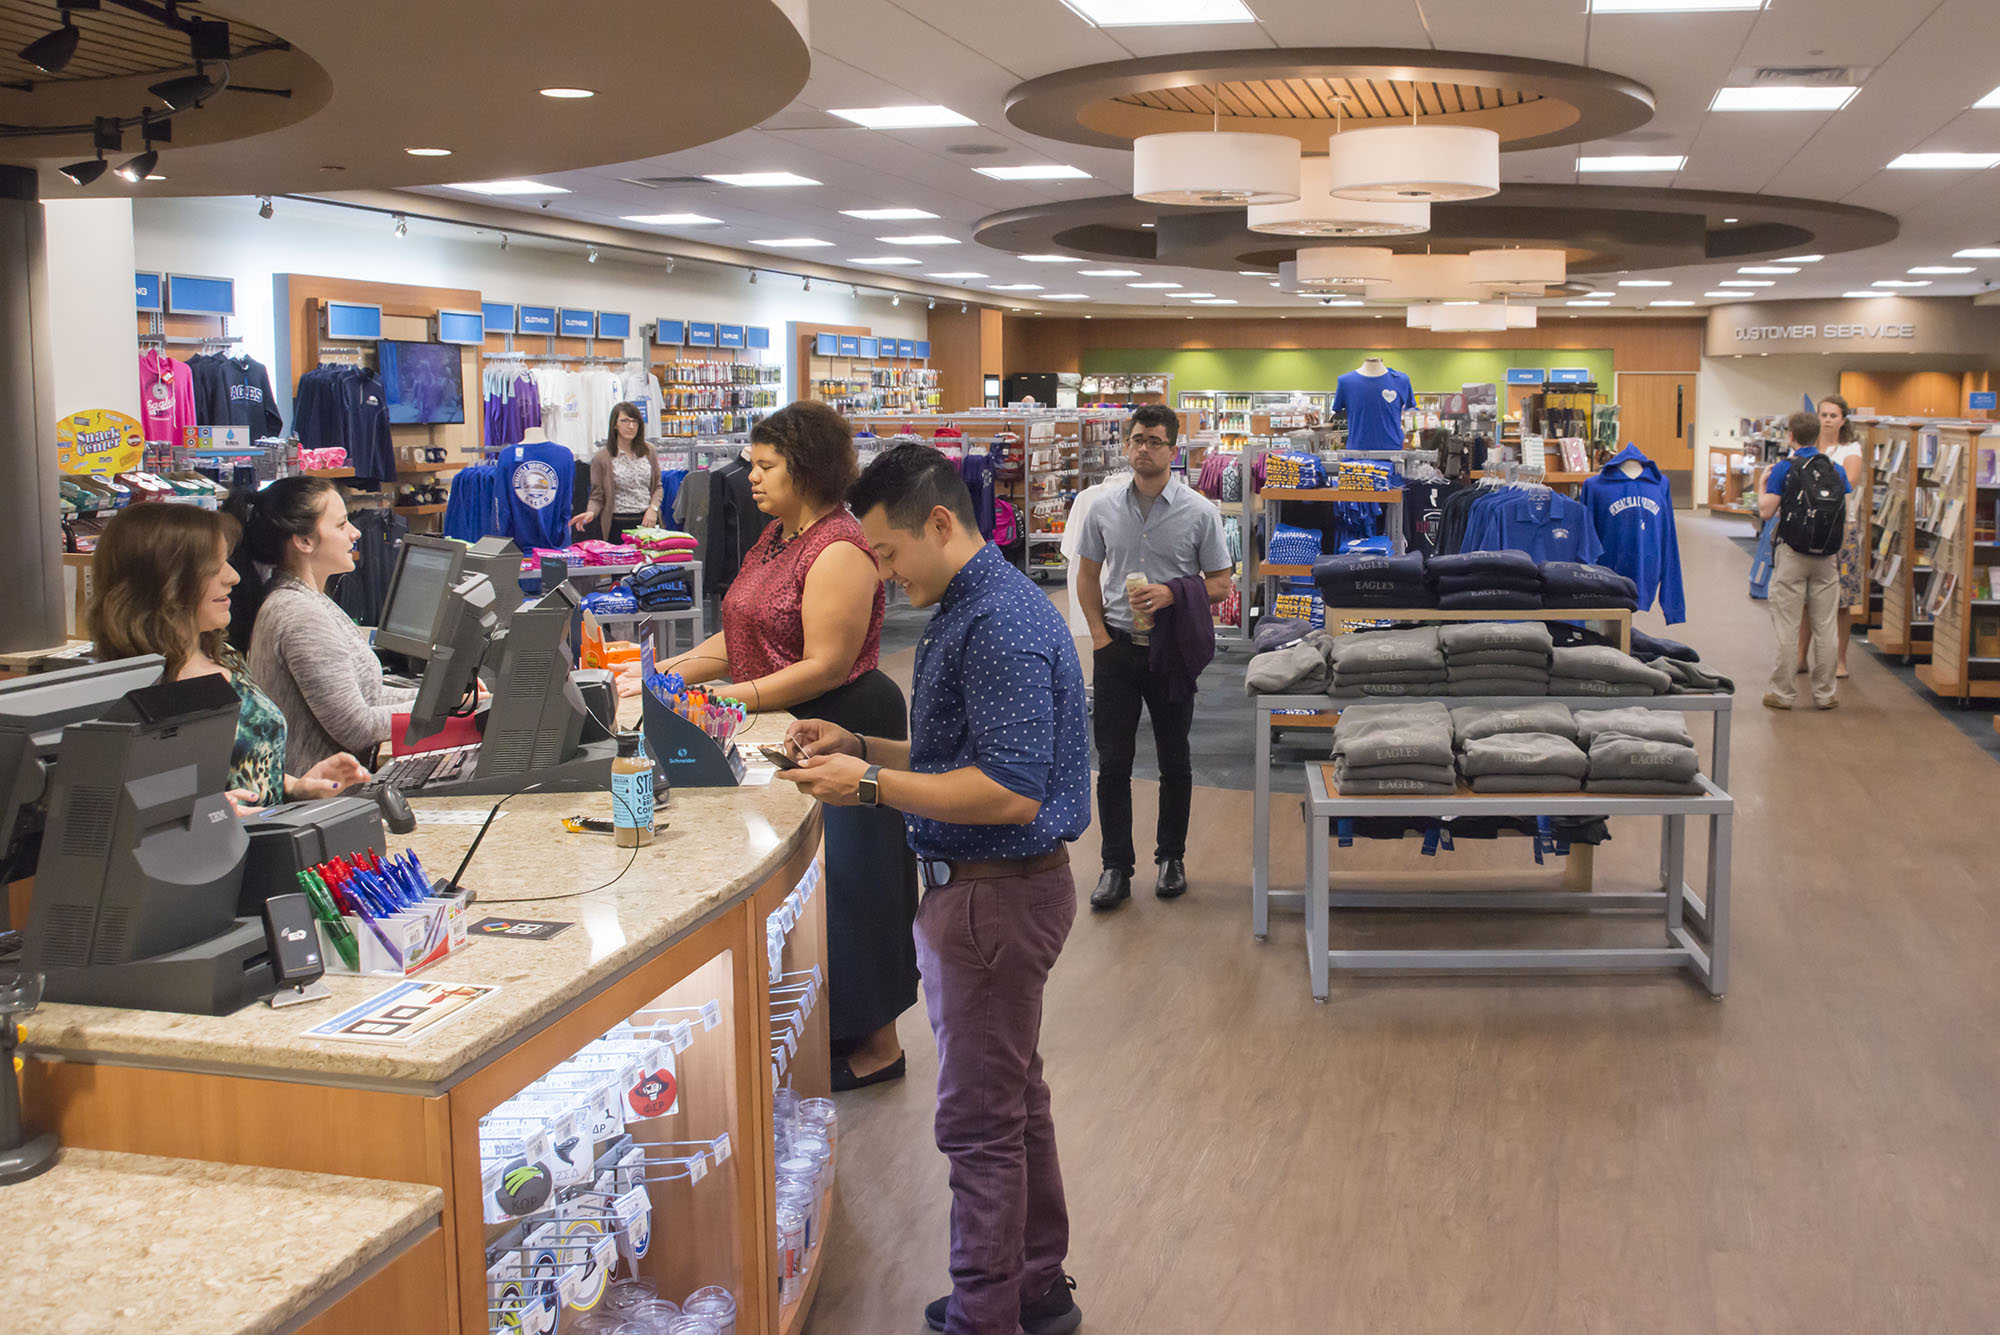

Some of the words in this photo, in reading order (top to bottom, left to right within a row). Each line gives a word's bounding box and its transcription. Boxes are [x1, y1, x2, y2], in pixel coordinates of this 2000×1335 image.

[1735, 325, 1816, 341] CUSTOMER
[1823, 323, 1914, 339] SERVICE
[77, 426, 121, 444] Snack
[77, 438, 121, 457] Center
[1350, 560, 1390, 571] EAGLES
[1355, 581, 1395, 590] EAGLES
[1363, 684, 1409, 693] EAGLES
[1580, 682, 1620, 695] EAGLES
[1376, 747, 1420, 760] EAGLES
[1630, 754, 1674, 765] EAGLES
[1378, 780, 1424, 790] EAGLES
[208, 809, 229, 824] IBM
